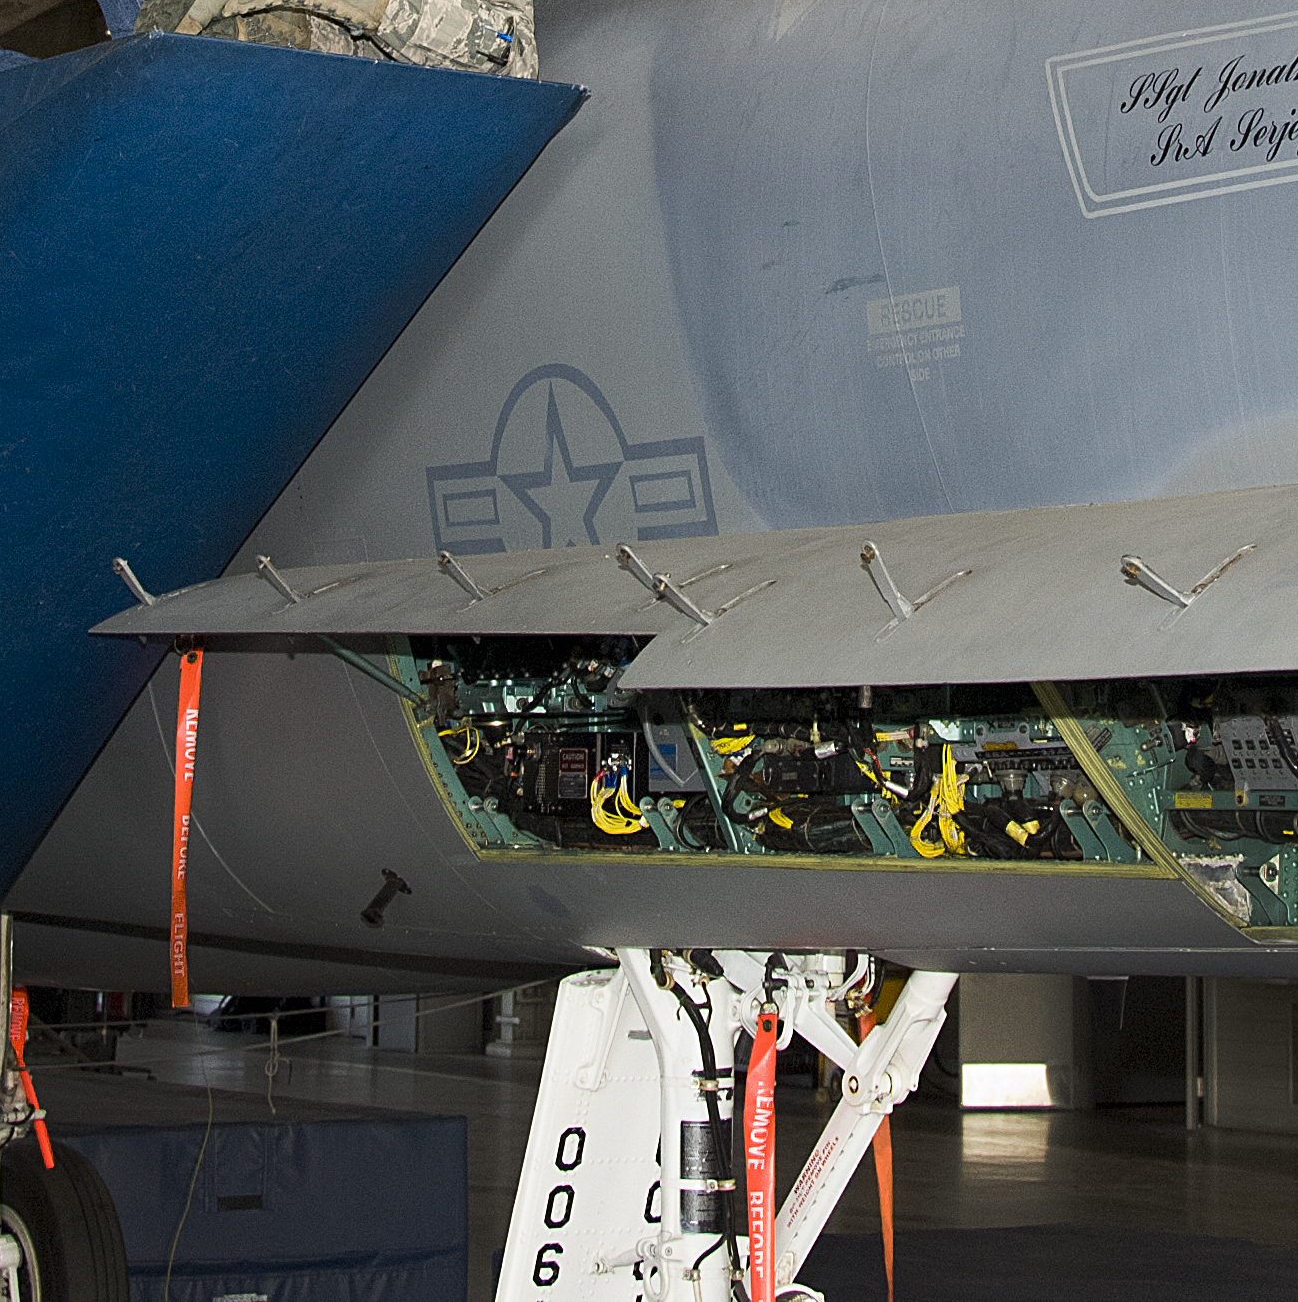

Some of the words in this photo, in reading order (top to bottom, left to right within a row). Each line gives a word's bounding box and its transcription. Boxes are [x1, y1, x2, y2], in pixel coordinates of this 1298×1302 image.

[1120, 67, 1203, 123] SSgt
[1150, 115, 1223, 167] SrA
[880, 295, 947, 326] RESCUE
[921, 325, 966, 344] ENTRANCE
[910, 367, 931, 381] SIDE
[918, 349, 932, 363] ON
[933, 344, 961, 359] OTHER
[184, 708, 199, 782] REMOVE
[178, 814, 191, 880] BEFORE
[174, 912, 185, 977] FLIGHT
[747, 1080, 774, 1171] EMOVE
[793, 1149, 820, 1194] WARNING
[821, 1136, 839, 1167] WHEELS
